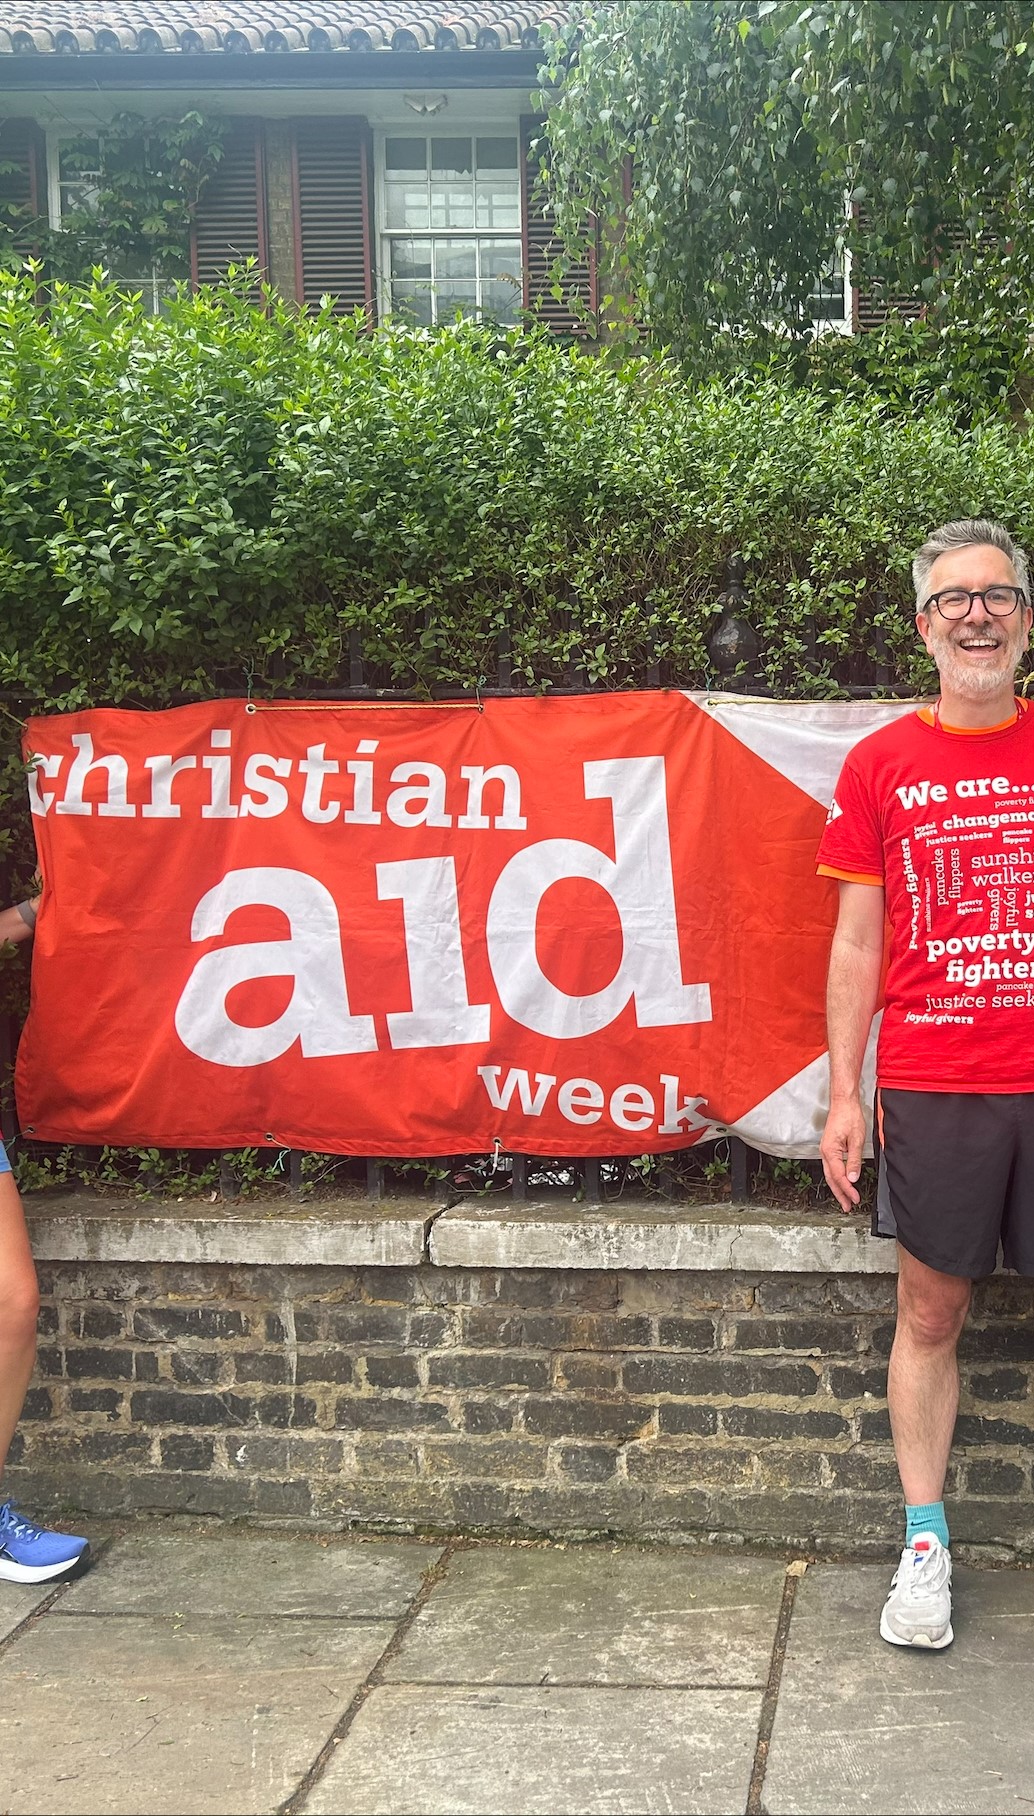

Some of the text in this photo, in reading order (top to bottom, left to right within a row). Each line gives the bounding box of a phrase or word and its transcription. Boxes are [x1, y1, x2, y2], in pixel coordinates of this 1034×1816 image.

[27, 729, 528, 831] christian
[895, 781, 948, 810] We
[994, 798, 1028, 809] poverty
[925, 831, 993, 848] justice seekers
[901, 837, 918, 893] fighters
[931, 847, 950, 907] pancake
[948, 848, 963, 899] flippers
[174, 755, 713, 1067] aid
[987, 888, 1004, 932] givers
[1003, 886, 1020, 928] joyful
[925, 993, 987, 1012] justice
[996, 981, 1034, 993] pancake
[904, 1012, 974, 1025] joyful givers
[477, 1064, 711, 1134] week
